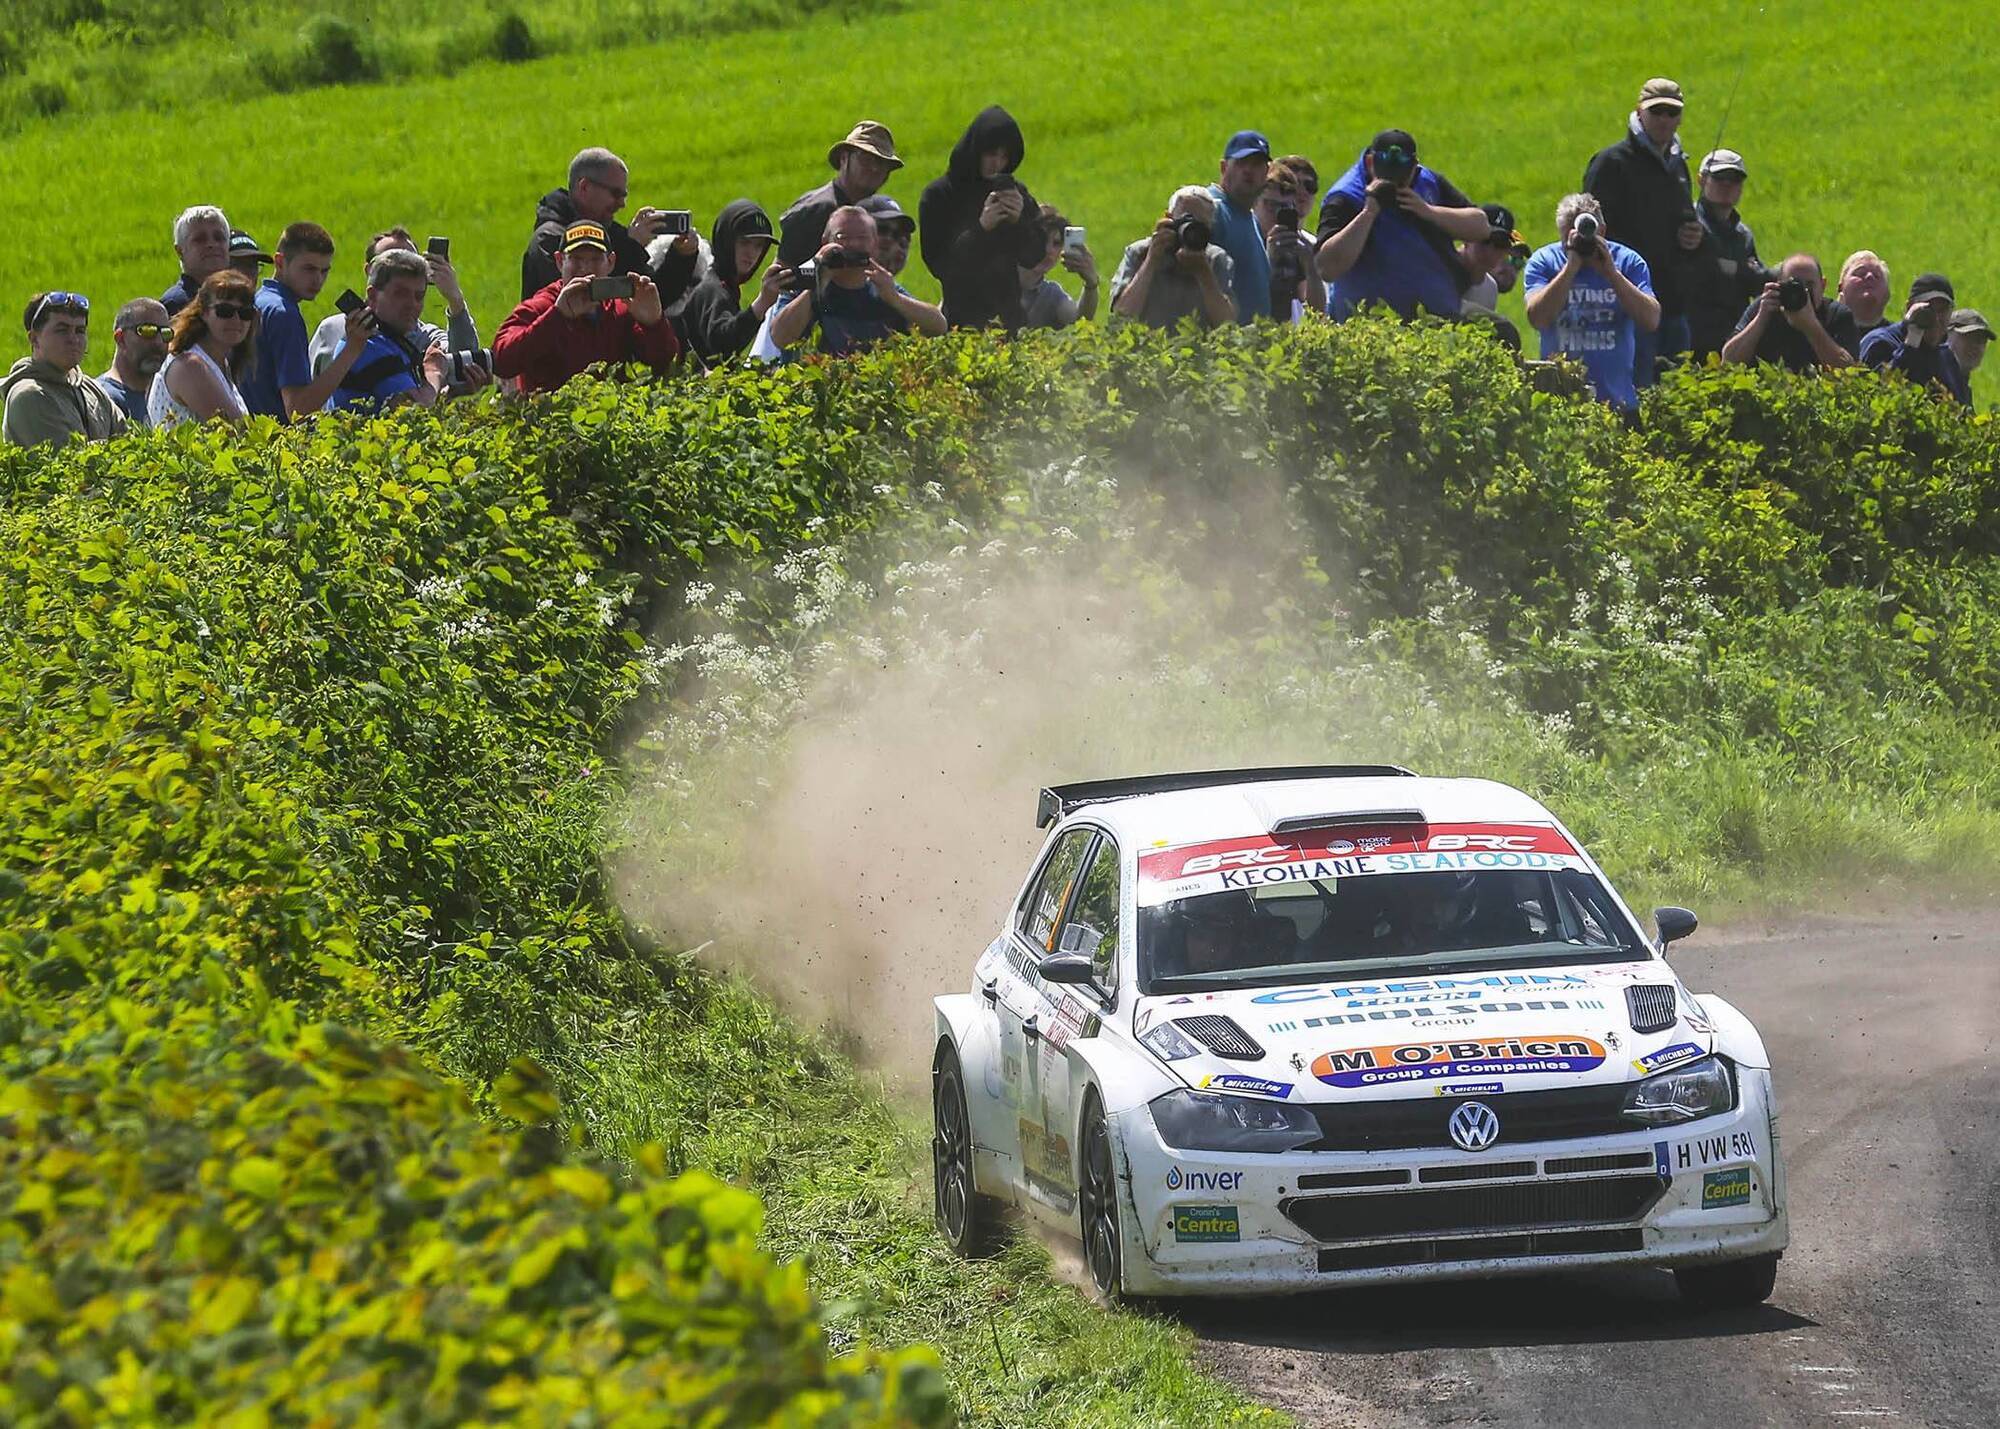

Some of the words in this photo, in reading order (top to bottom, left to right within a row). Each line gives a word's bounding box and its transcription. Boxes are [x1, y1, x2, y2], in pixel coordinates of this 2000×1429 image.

[1569, 288, 1616, 304] LYING
[1427, 835, 1538, 850] BRC
[1181, 845, 1292, 875] BRC
[1221, 856, 1376, 889] KEOHANE
[1386, 852, 1567, 870] SEAFOODS
[1251, 974, 1587, 1005] CREMIN
[1411, 1017, 1475, 1028] Group
[1330, 1051, 1377, 1073] M
[1392, 1038, 1592, 1065] O'Brien
[1656, 1047, 1696, 1064] MICHELIN
[1361, 1068, 1424, 1082] Group
[1429, 1065, 1449, 1075] of
[1456, 1061, 1571, 1074] Companies
[1225, 1080, 1282, 1092] MICHELIN
[1677, 1143, 1691, 1168] H
[1697, 1136, 1727, 1164] VW
[1186, 1172, 1243, 1190] inver
[1705, 1181, 1749, 1200] Centra
[1177, 1216, 1237, 1232] Centra
